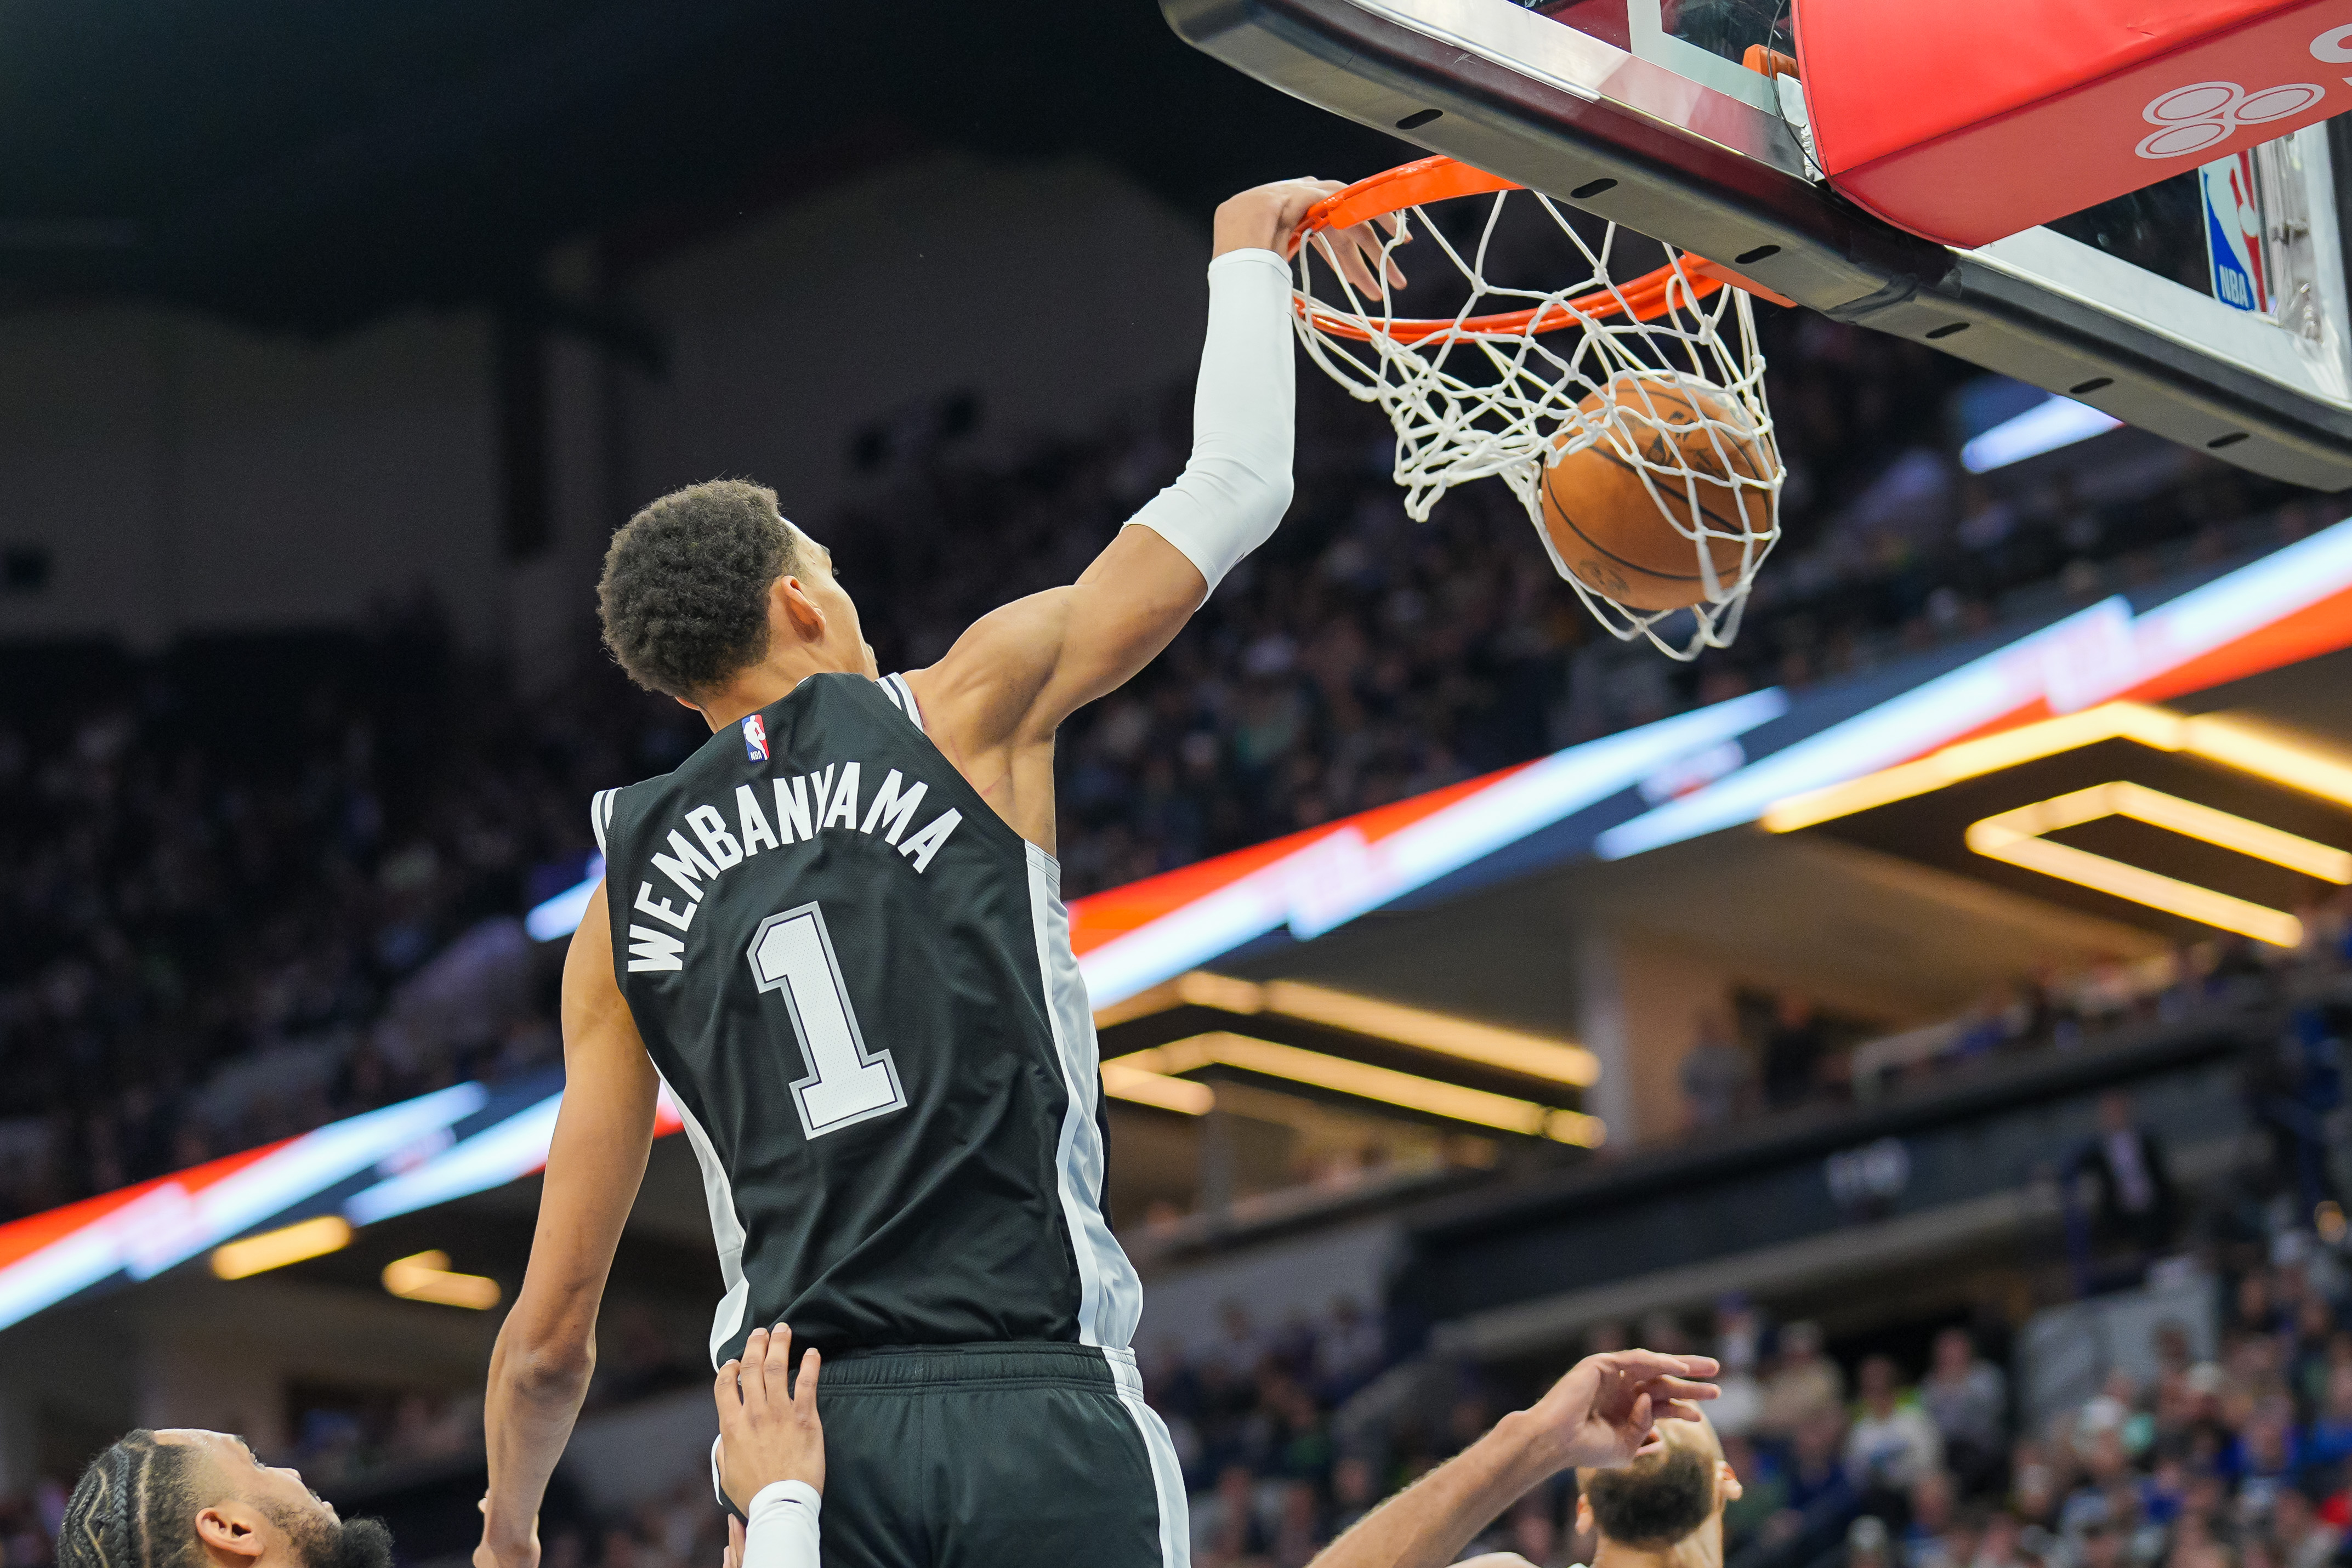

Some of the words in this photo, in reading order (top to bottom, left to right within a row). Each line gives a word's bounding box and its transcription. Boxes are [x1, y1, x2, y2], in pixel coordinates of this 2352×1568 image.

[2219, 265, 2249, 308] NBA
[750, 751, 763, 760] NBA
[628, 762, 963, 972] WEMBANYAMA
[747, 900, 907, 1140] 1
